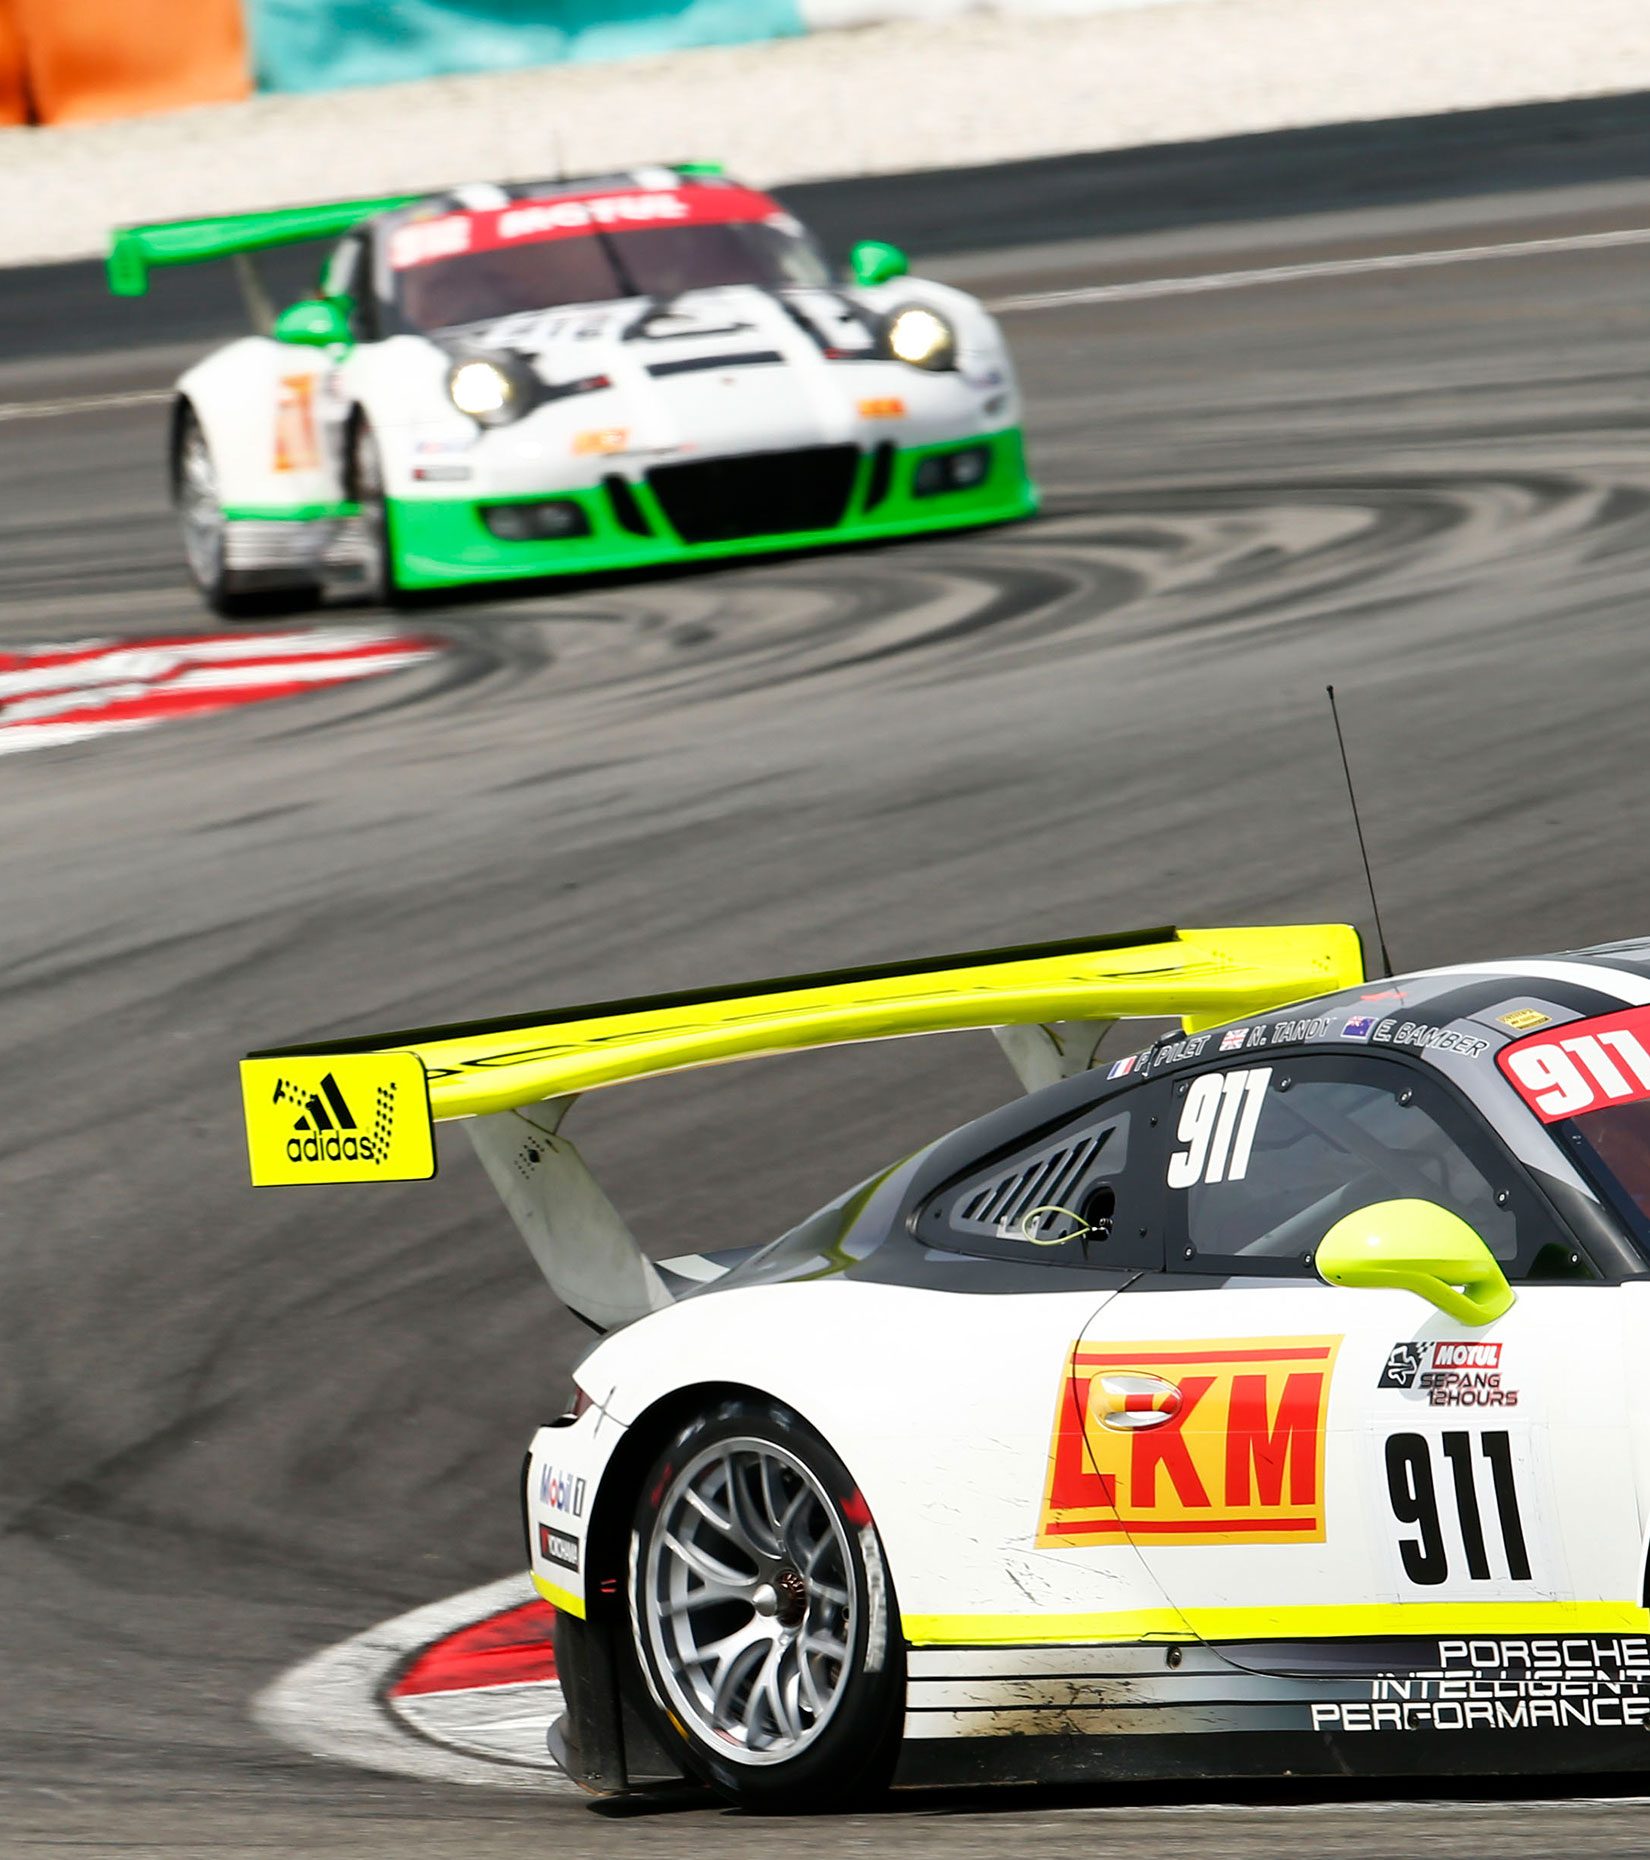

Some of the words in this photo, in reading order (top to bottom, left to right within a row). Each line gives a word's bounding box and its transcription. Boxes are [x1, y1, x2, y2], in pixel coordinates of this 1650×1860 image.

[1247, 1025, 1266, 1047] N.
[1271, 1016, 1337, 1044] TANDY
[1373, 1019, 1397, 1042] E.
[1394, 1022, 1490, 1058] BAMBER
[1154, 1035, 1211, 1067] PILET
[1167, 1067, 1272, 1189] 911
[287, 1130, 375, 1162] adidas
[1435, 1345, 1498, 1366] MOTUL
[1420, 1372, 1502, 1389] SEPANG
[1429, 1390, 1519, 1406] 12HOURS
[1049, 1371, 1324, 1510] LKM
[540, 1463, 573, 1512] Mobil
[1385, 1430, 1532, 1585] 911
[1438, 1638, 1650, 1668] PORSCHE
[1371, 1669, 1650, 1700] INTELLIGENT
[1309, 1698, 1650, 1731] PERFORMANCE
